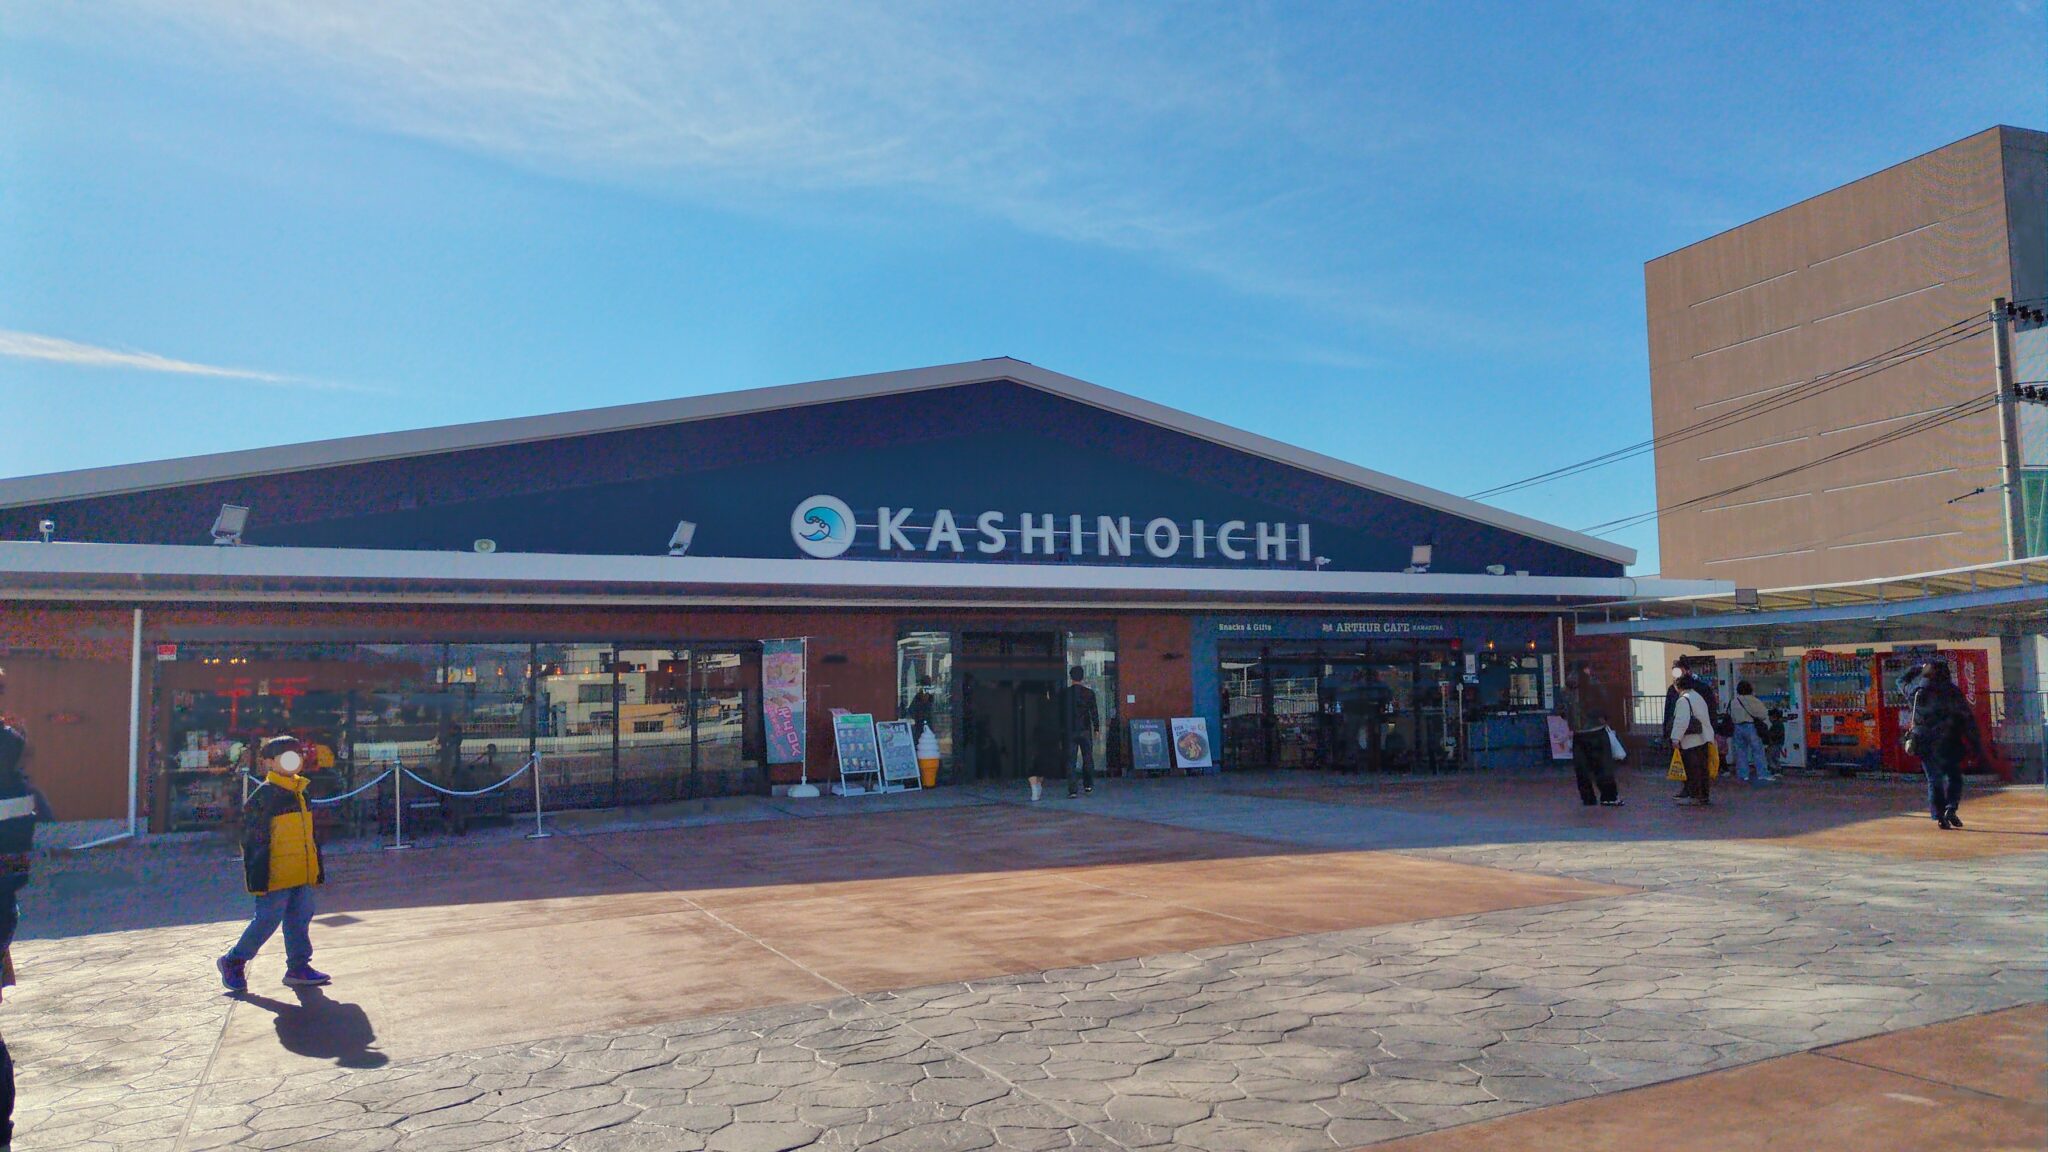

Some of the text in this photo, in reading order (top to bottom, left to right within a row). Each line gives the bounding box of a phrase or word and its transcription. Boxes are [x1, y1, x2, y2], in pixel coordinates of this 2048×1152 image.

[877, 507, 1311, 562] KASHINOICHI
[1218, 623, 1272, 632] Snacks & Gifts
[1336, 622, 1381, 633] ARTHUR
[1383, 622, 1410, 633] CAFE
